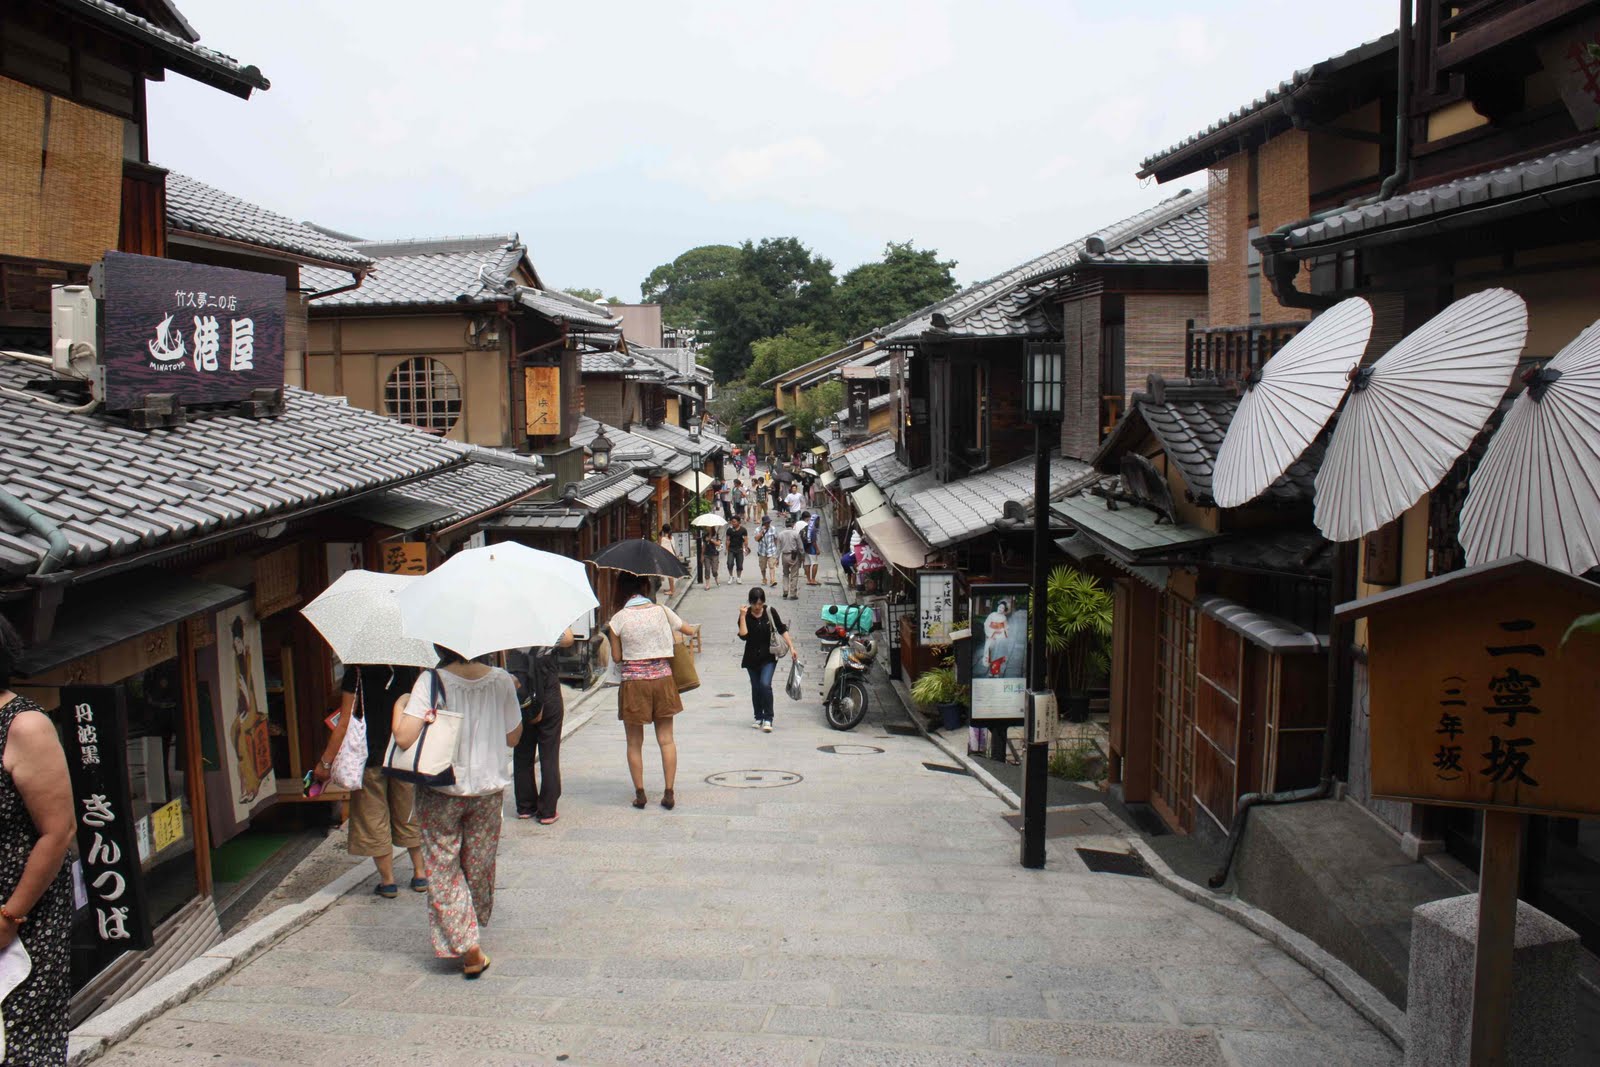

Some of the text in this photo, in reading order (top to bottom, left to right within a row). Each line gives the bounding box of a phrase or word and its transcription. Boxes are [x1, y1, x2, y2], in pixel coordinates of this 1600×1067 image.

[175, 290, 237, 311] 竹久夢二の店
[194, 315, 254, 372] 港屋
[150, 361, 186, 371] MINATOYA
[943, 580, 952, 607] そば処
[1480, 618, 1545, 787] 二寧坂
[82, 793, 131, 940] きんつば
